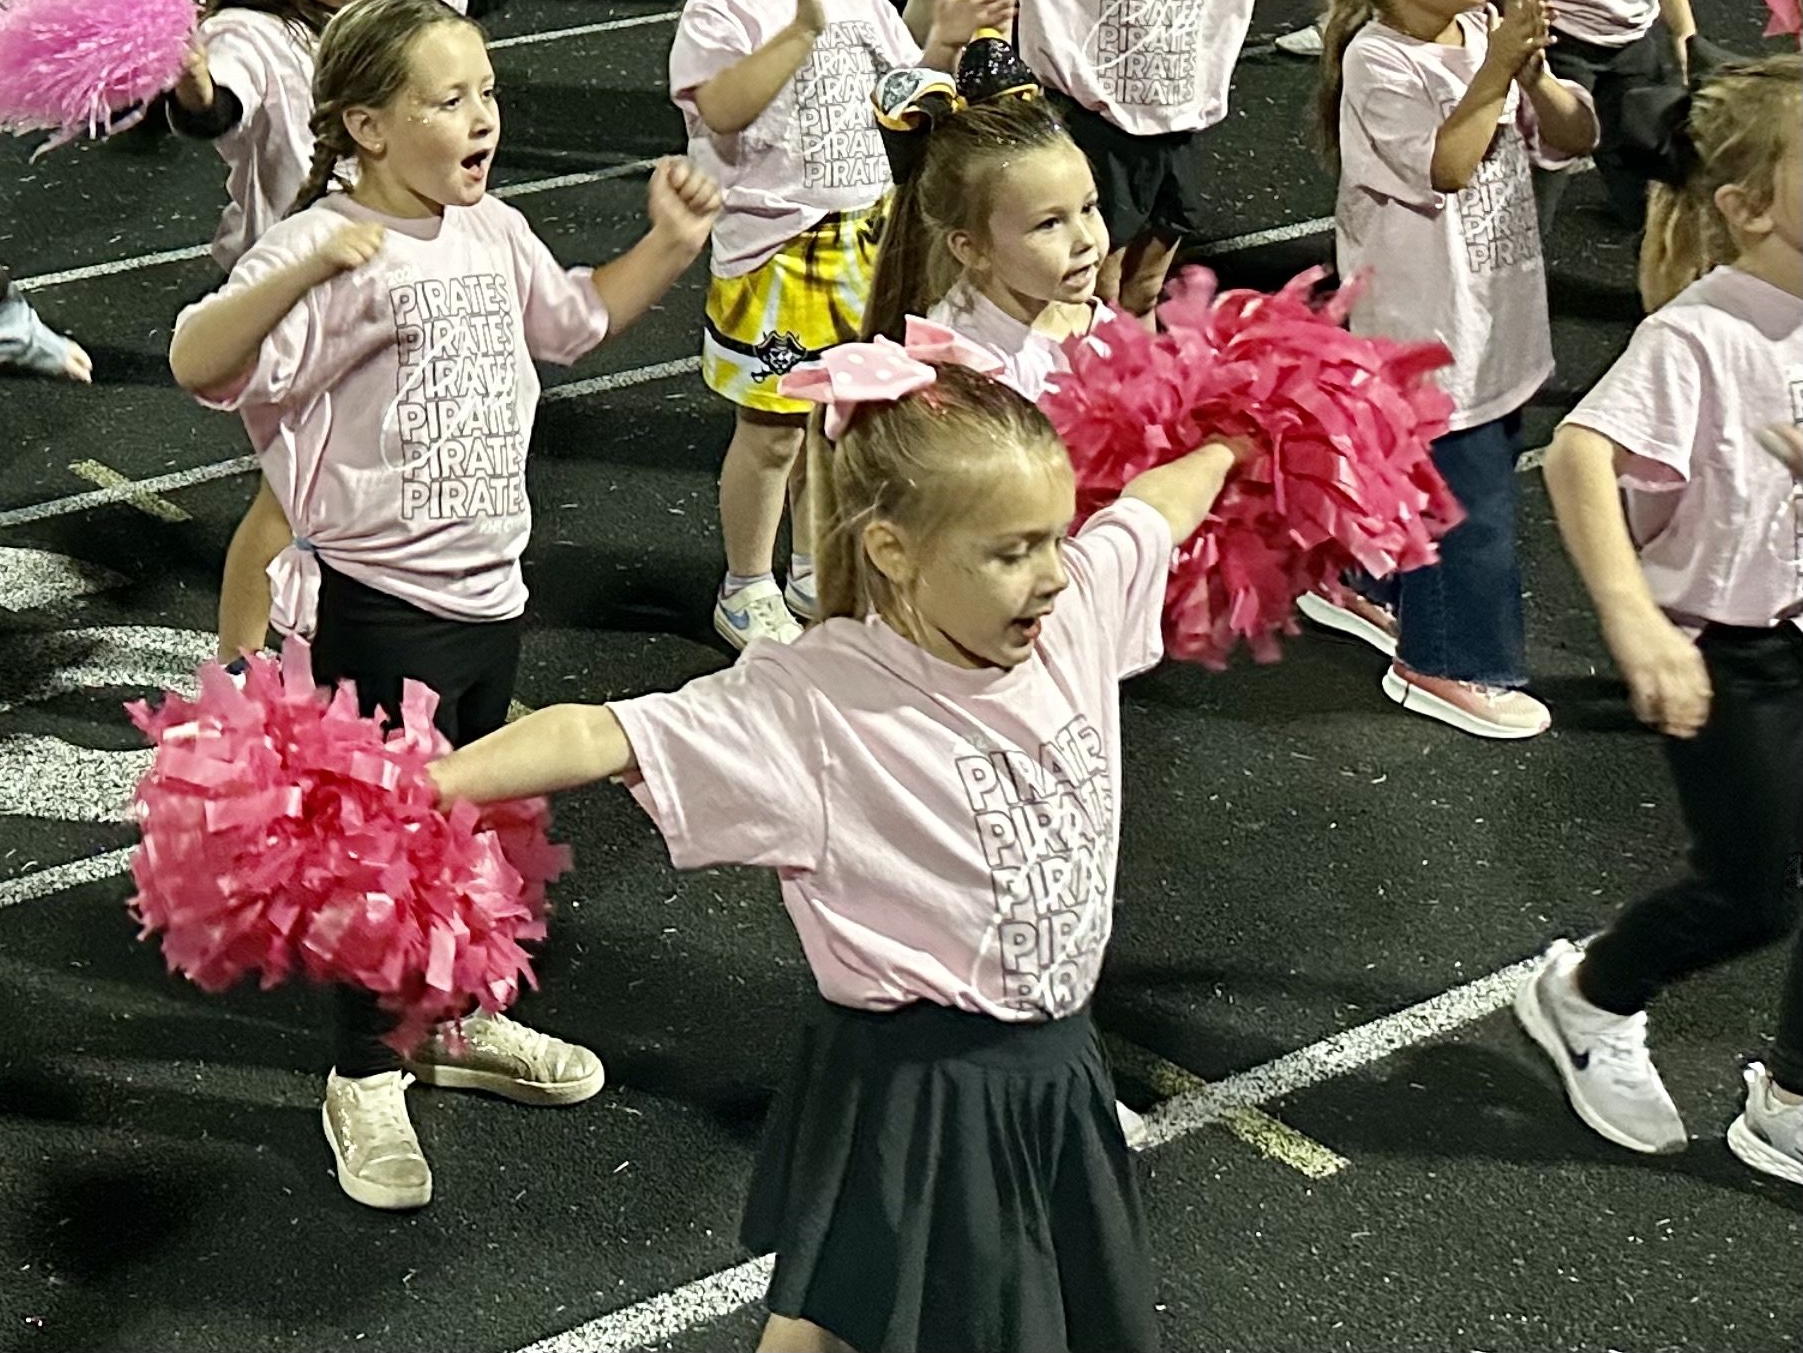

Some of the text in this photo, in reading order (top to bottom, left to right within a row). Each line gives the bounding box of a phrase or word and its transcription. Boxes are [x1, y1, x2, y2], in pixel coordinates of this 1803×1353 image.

[804, 155, 893, 189] PIRATE
[389, 273, 512, 327] PIRATES
[396, 312, 515, 366] PIRATES
